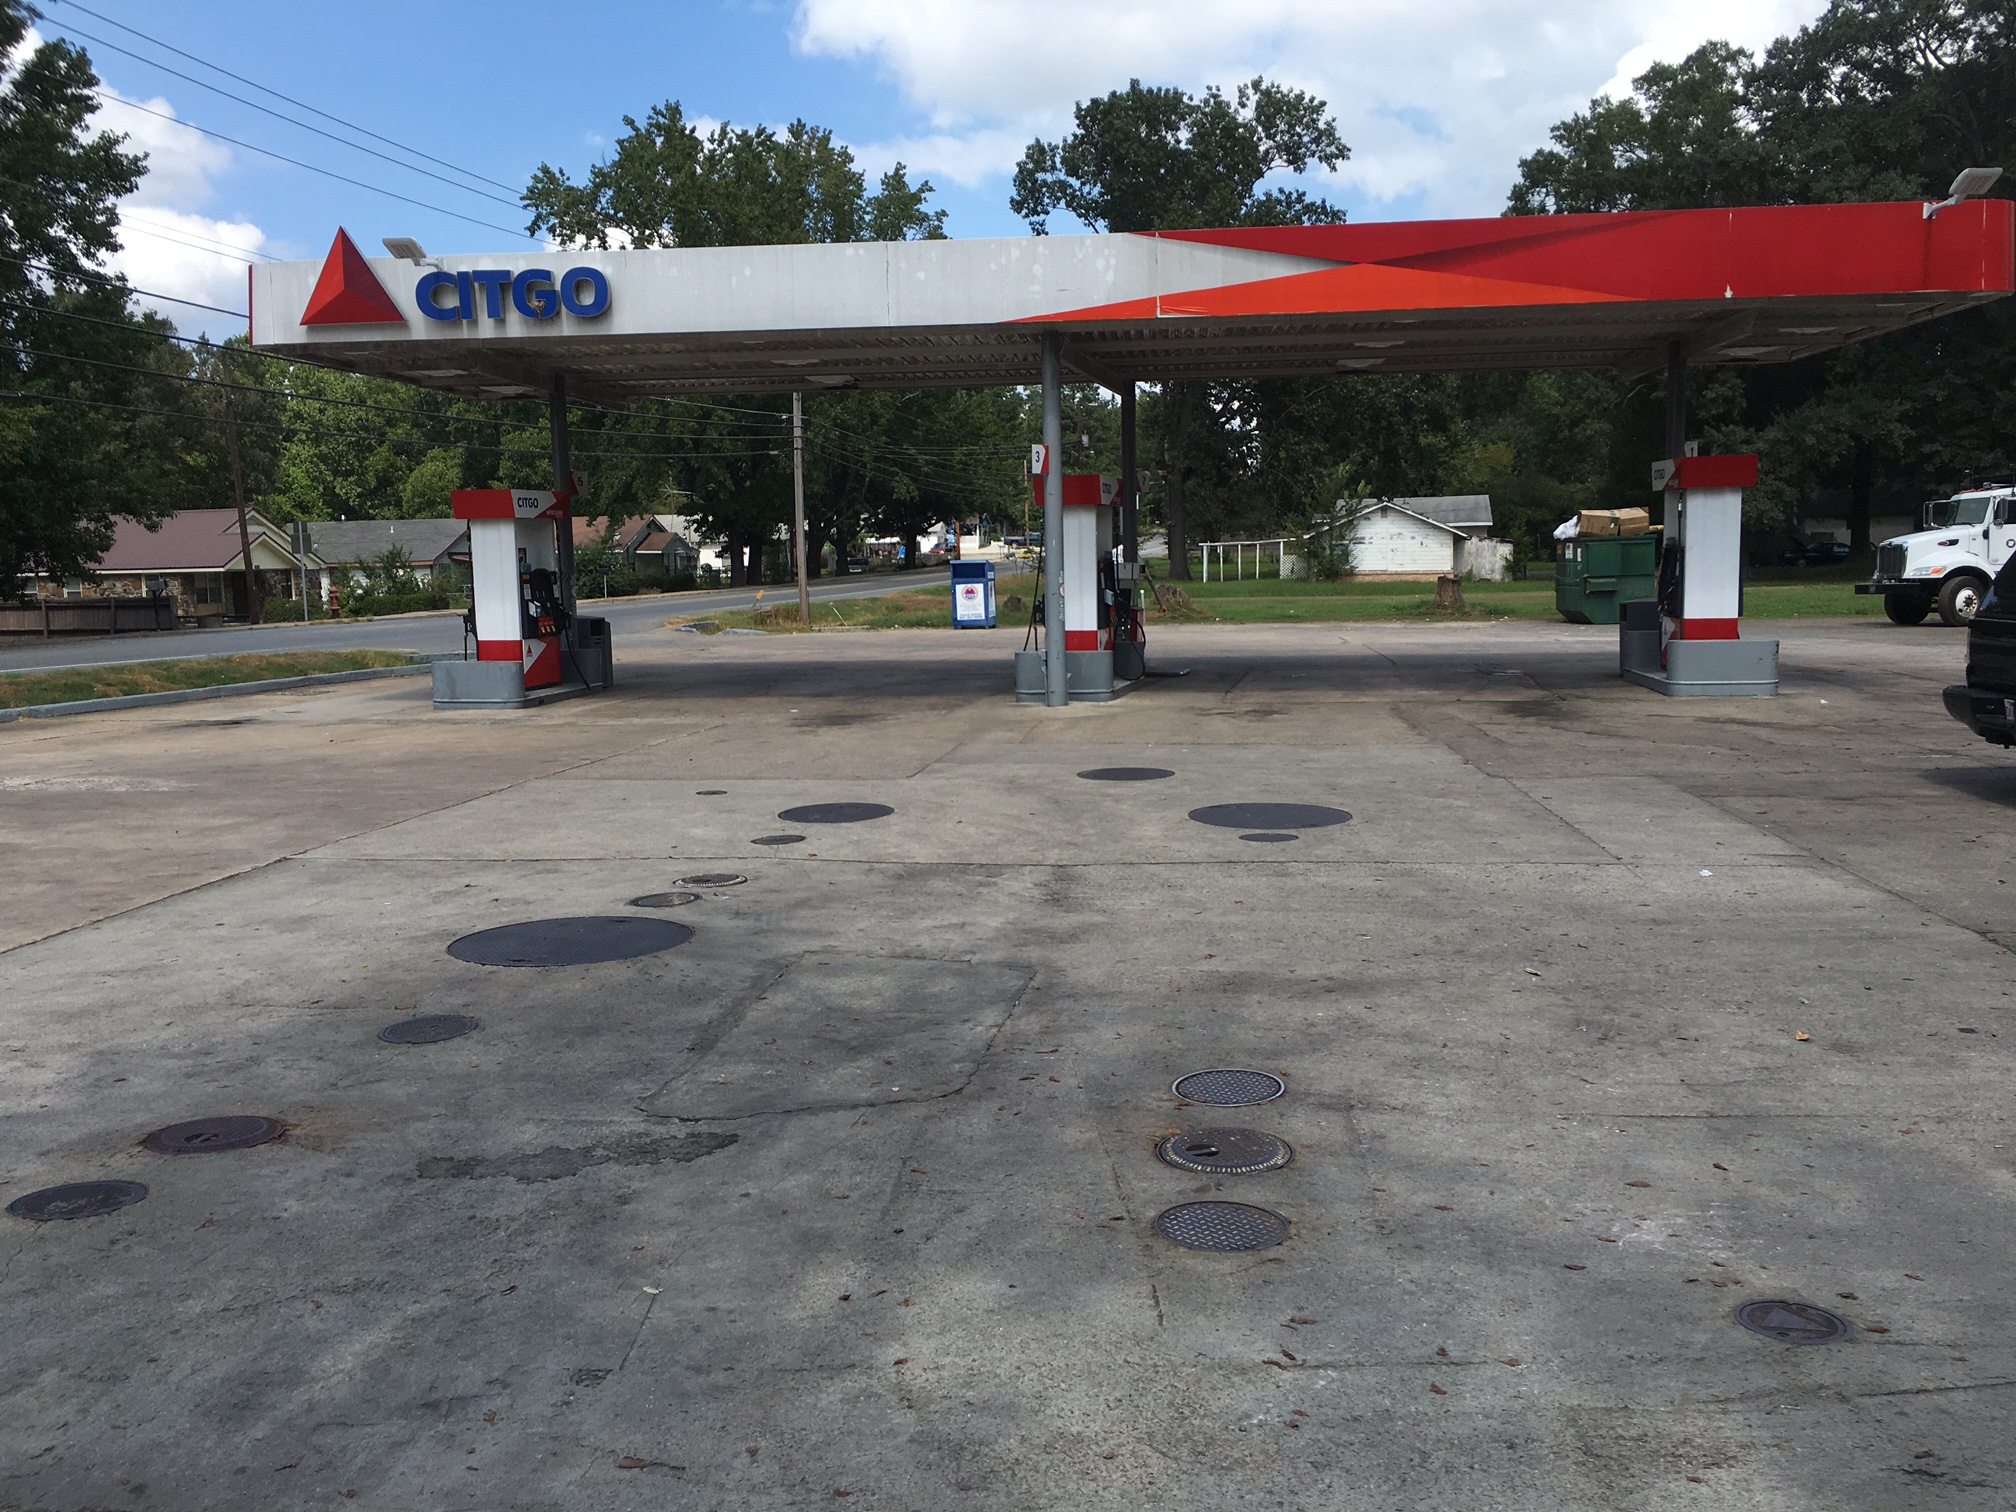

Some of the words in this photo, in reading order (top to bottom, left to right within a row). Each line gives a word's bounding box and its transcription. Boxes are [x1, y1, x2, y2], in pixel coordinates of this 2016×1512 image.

[415, 266, 610, 322] CITGO
[1036, 450, 1040, 462] 3
[578, 476, 584, 486] 5
[517, 497, 538, 508] CITGO
